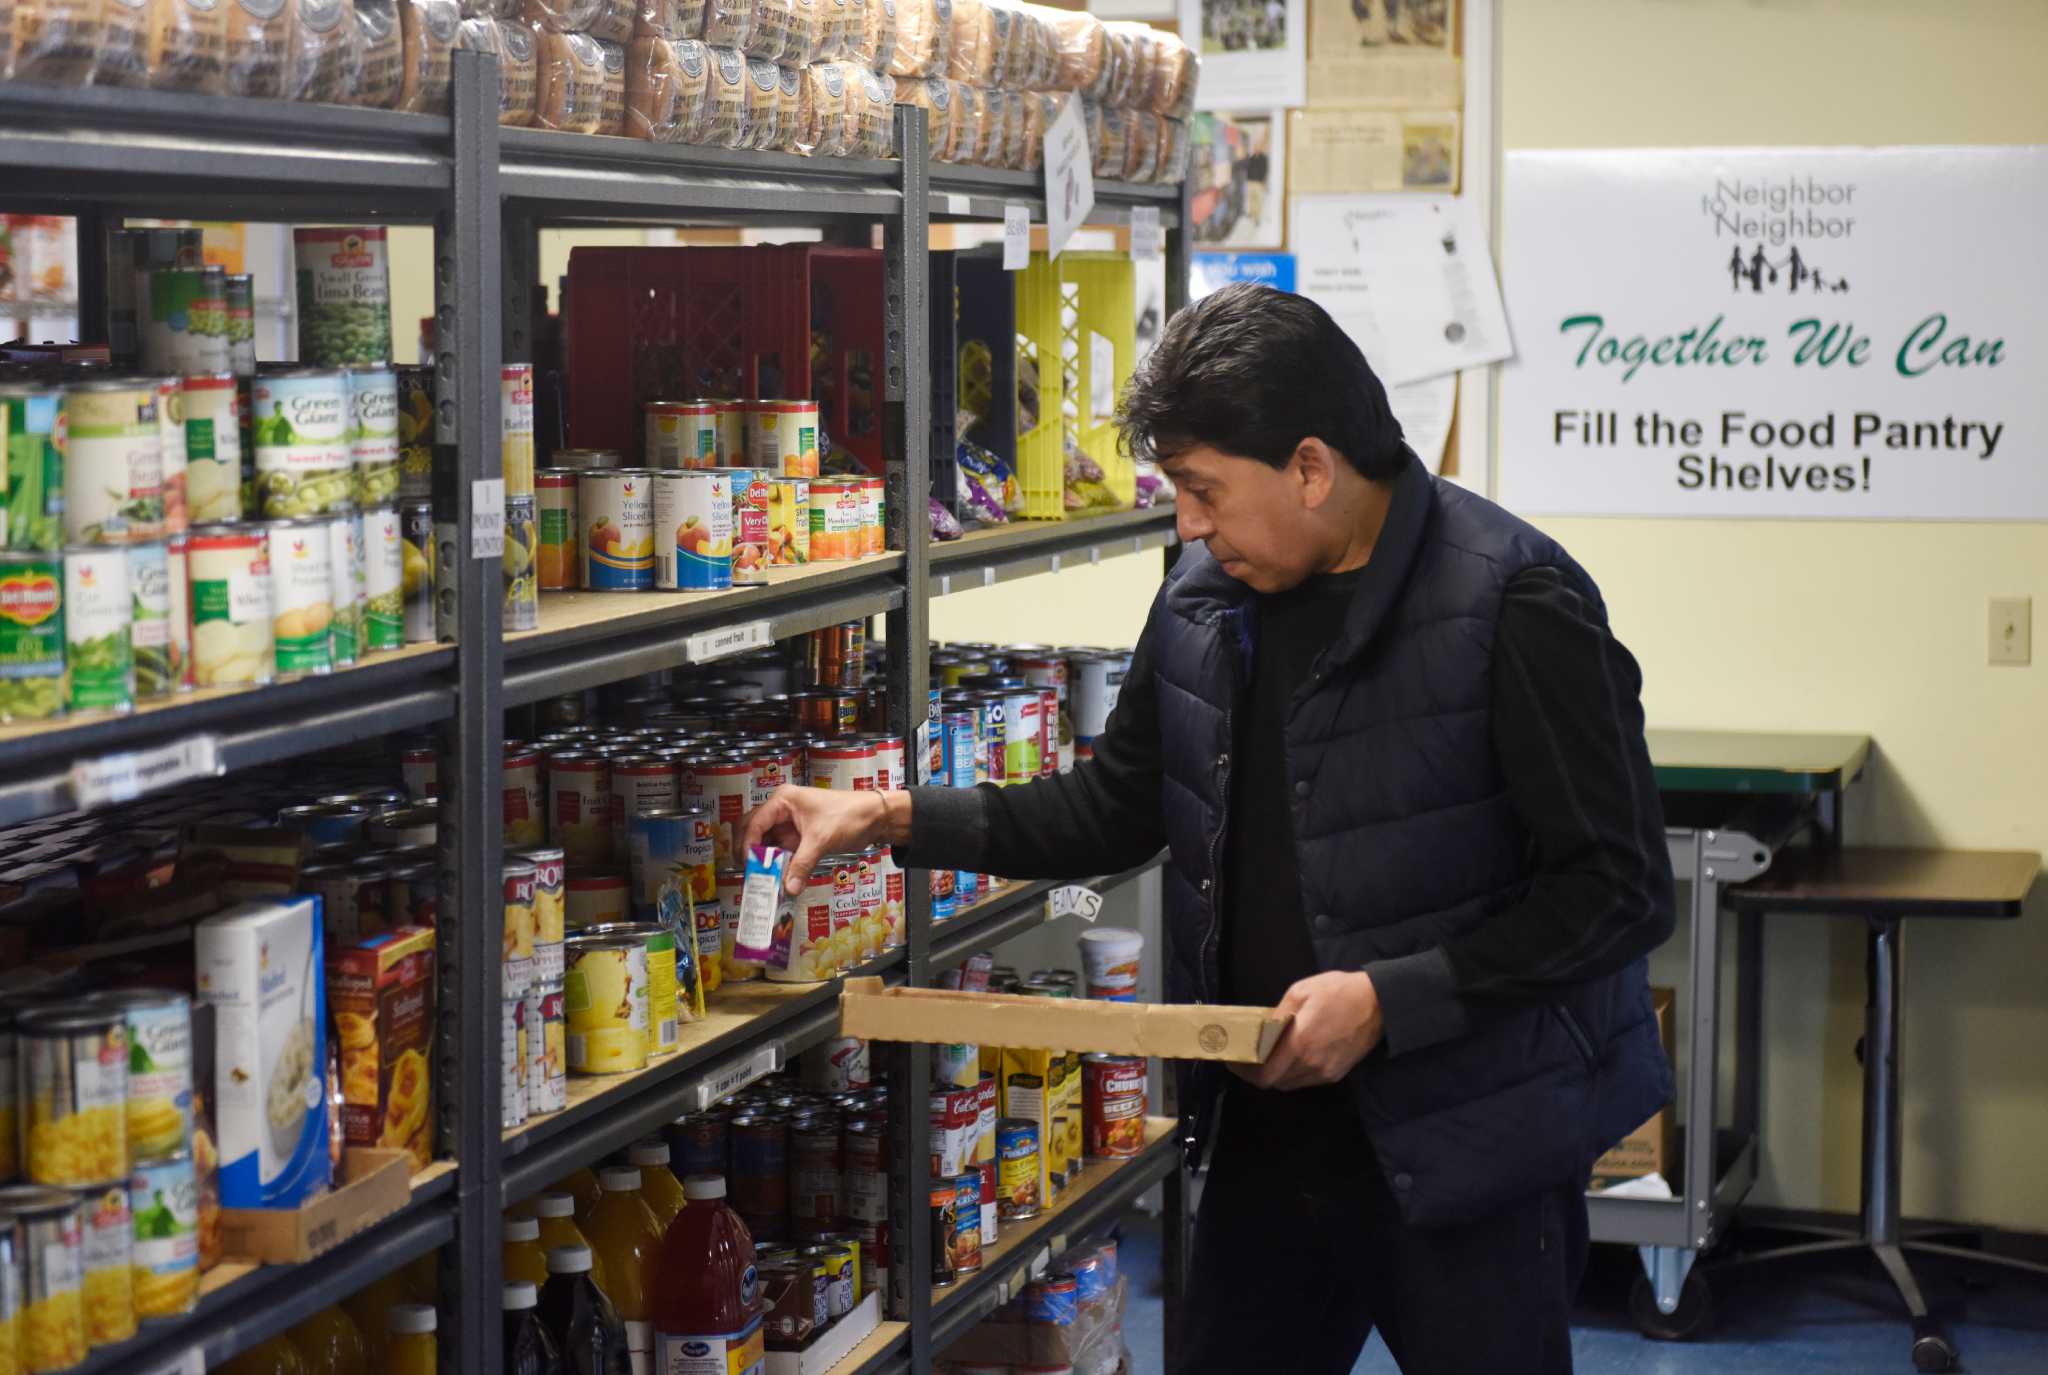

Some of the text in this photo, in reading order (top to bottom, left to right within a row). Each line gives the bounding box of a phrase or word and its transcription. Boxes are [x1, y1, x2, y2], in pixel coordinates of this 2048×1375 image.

[1702, 195, 1727, 216] to
[1715, 176, 1856, 212] Neighbor
[1715, 211, 1856, 246] Neighbor
[1560, 312, 2007, 384] Together We Can
[1553, 410, 2004, 460] Fill the Food Pantry
[1677, 455, 1872, 493] Shelves!
